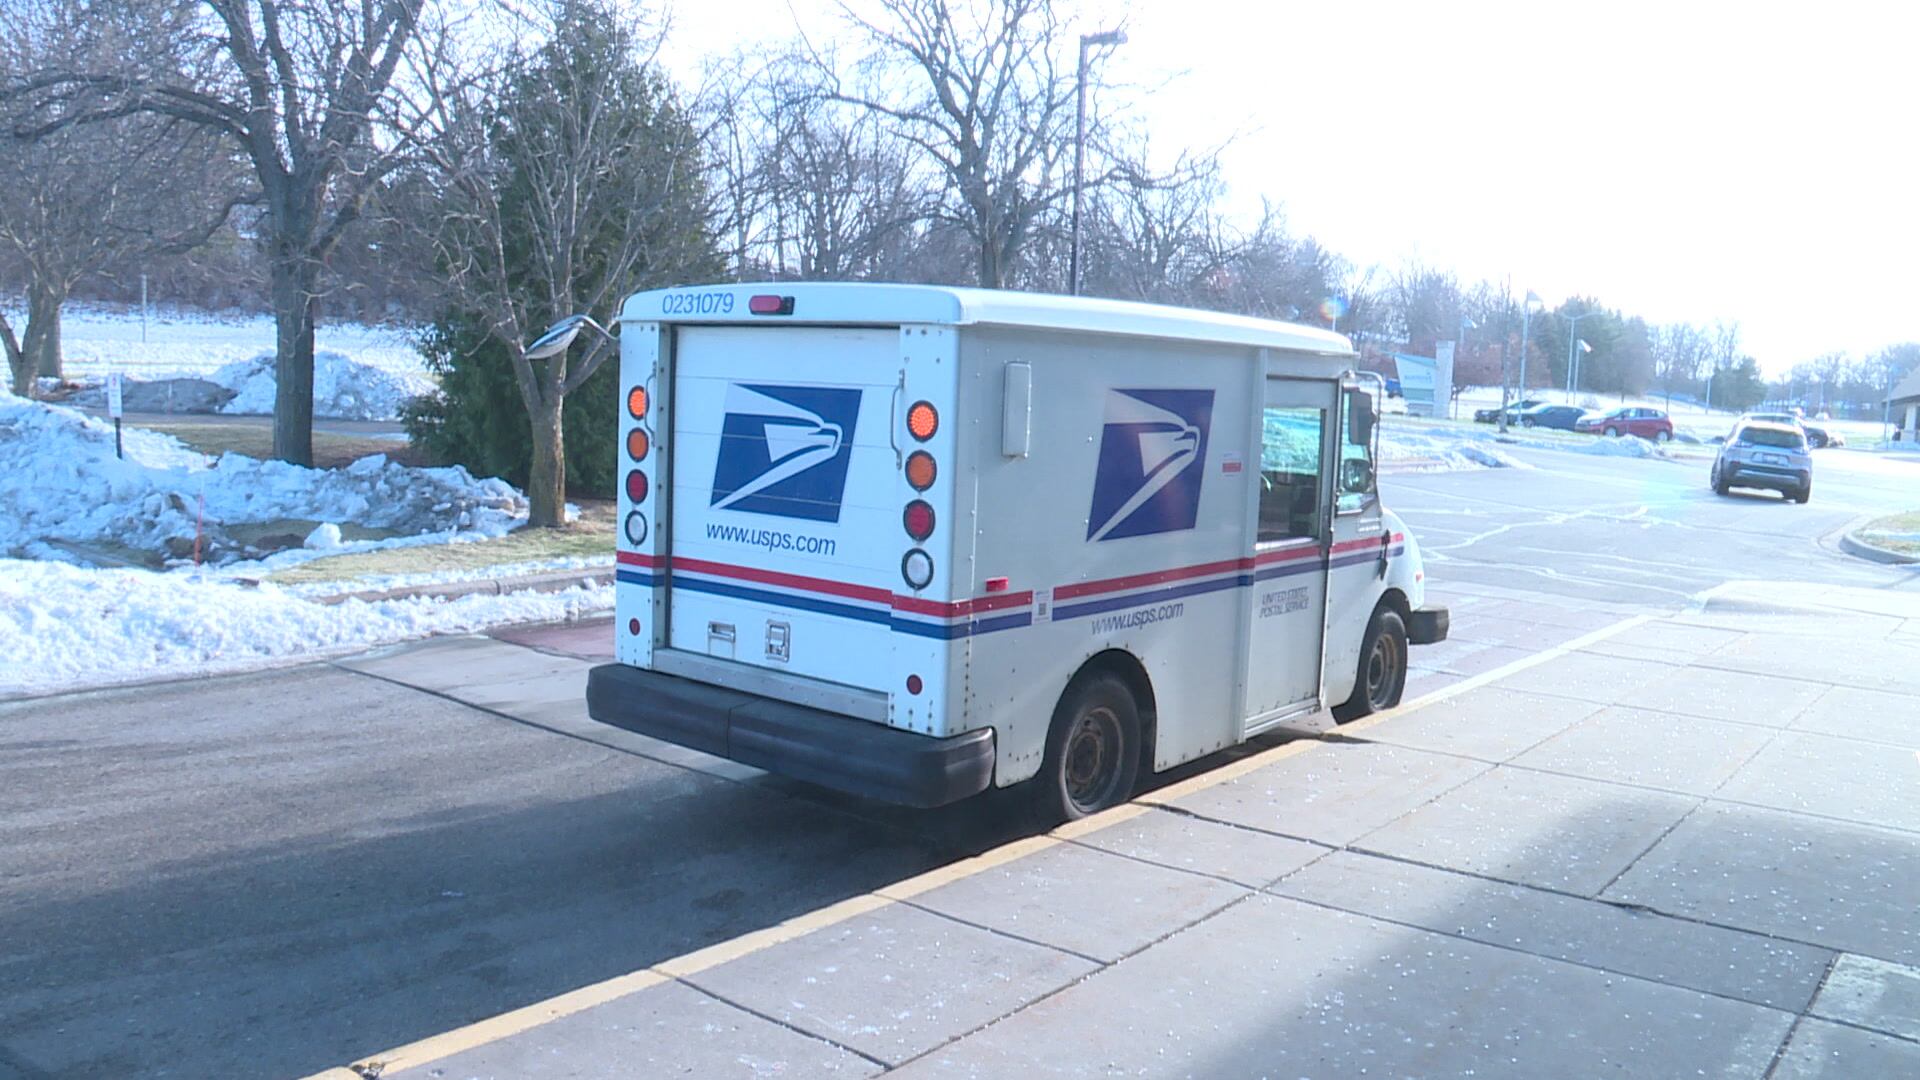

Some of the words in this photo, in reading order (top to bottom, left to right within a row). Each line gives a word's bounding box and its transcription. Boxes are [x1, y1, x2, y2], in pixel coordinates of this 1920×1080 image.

[662, 292, 734, 314] 0231079
[706, 522, 836, 556] www.usps.com
[1262, 590, 1287, 605] UNITED
[1091, 602, 1184, 635] www.usps.com
